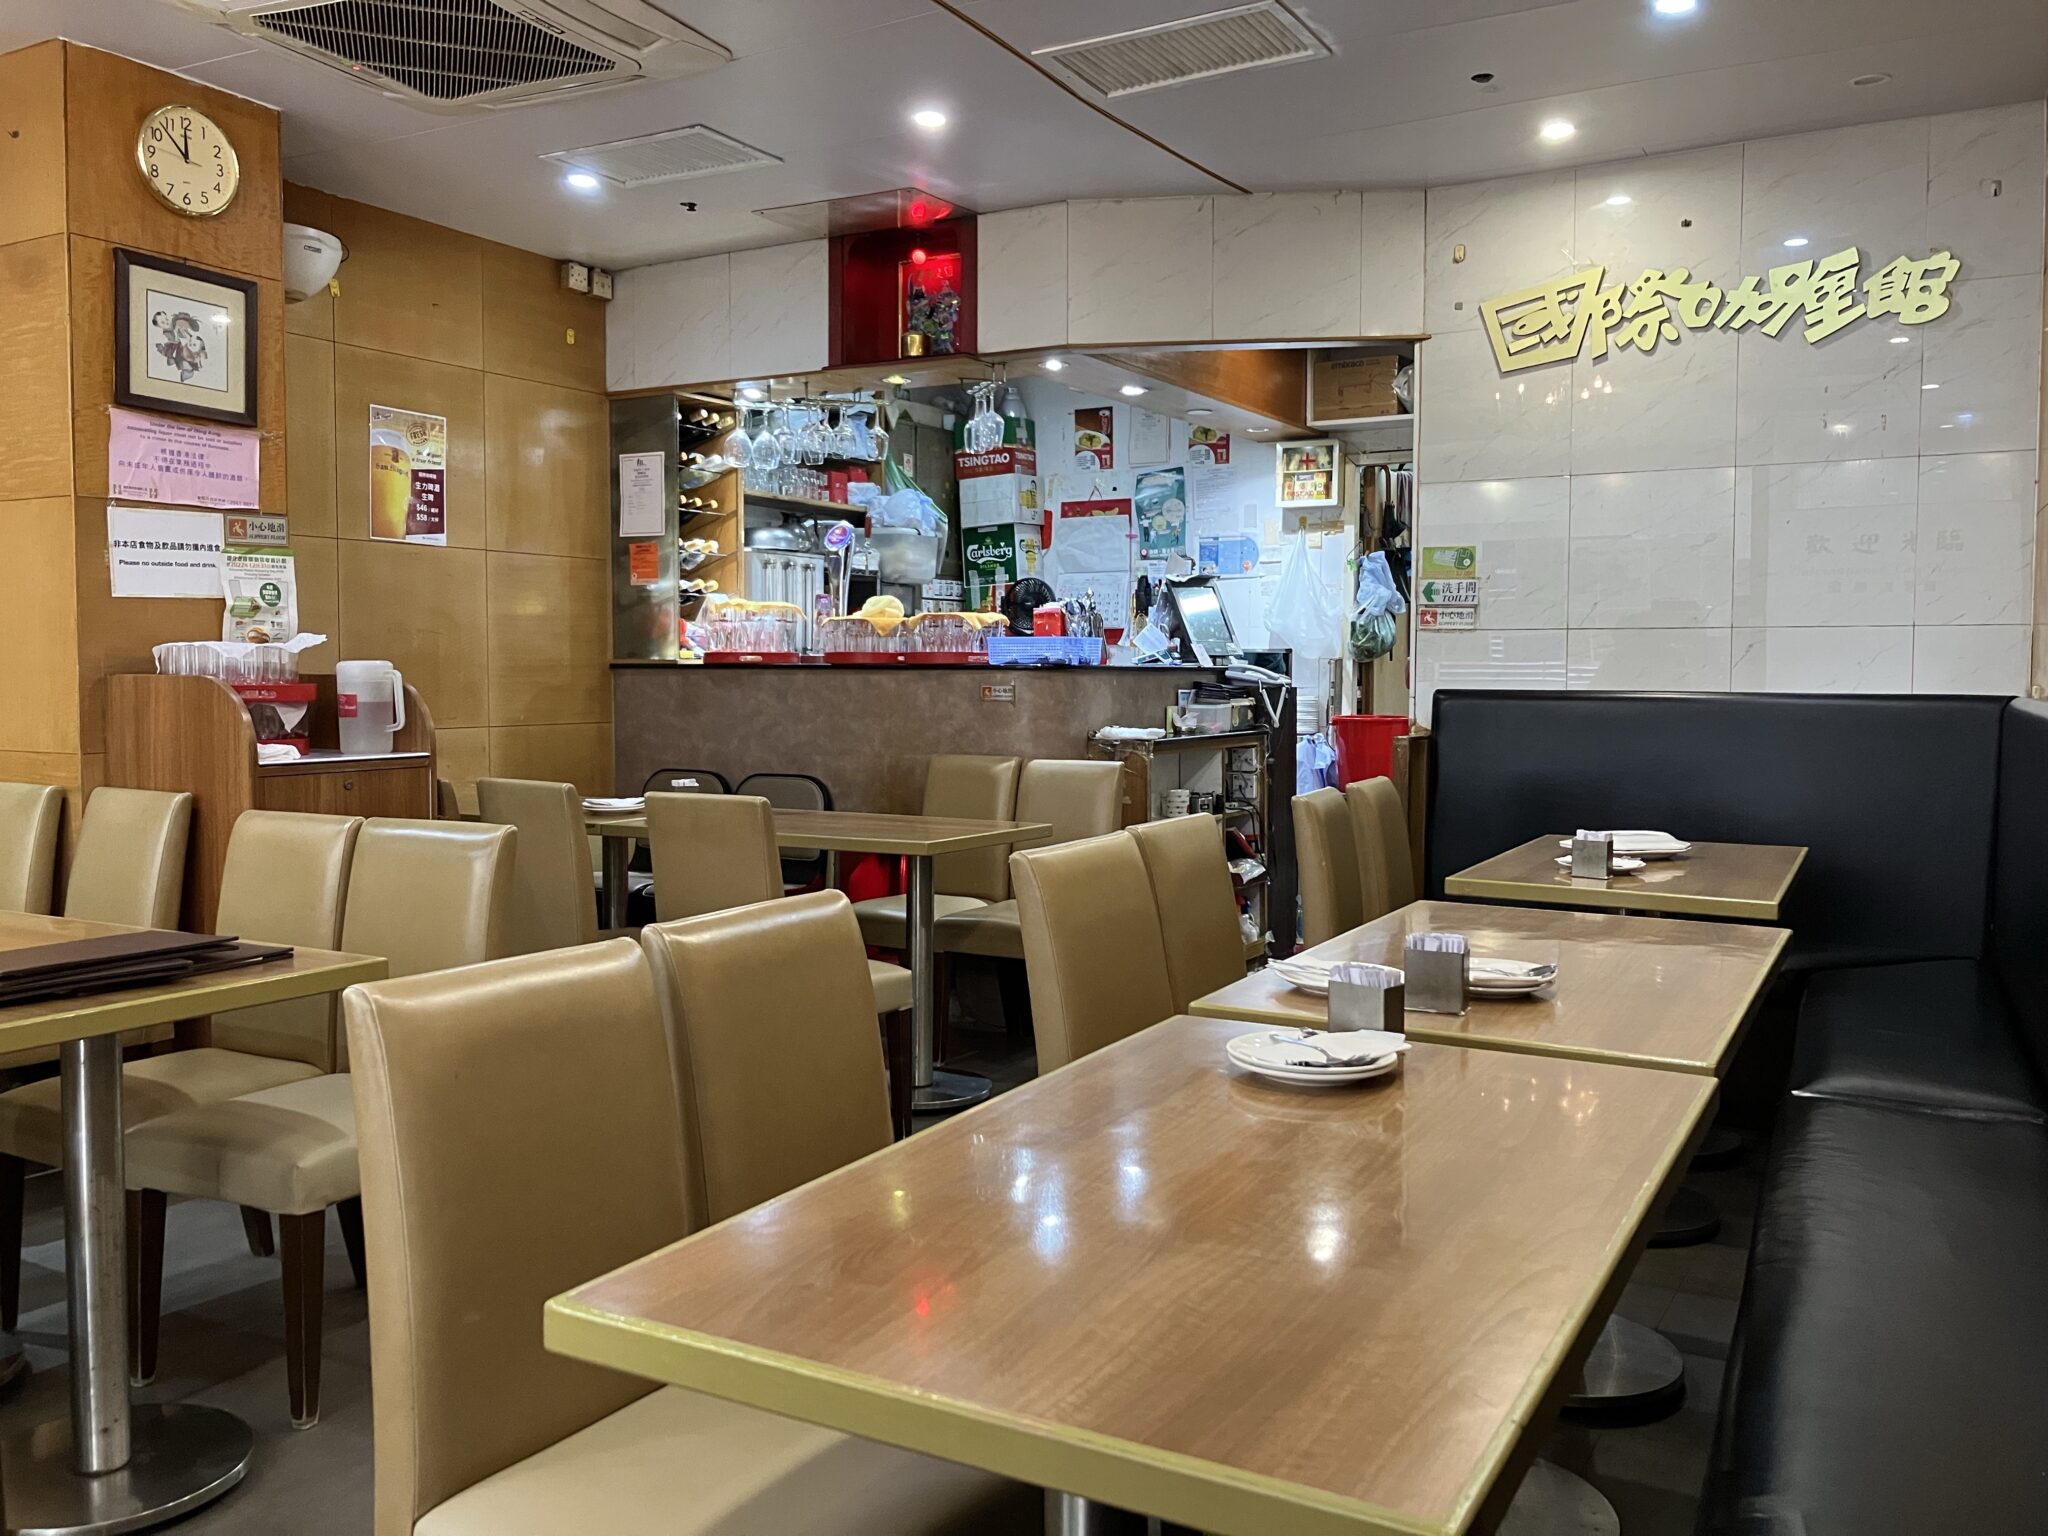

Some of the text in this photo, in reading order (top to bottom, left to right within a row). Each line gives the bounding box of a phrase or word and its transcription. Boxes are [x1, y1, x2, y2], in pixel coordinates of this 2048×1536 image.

[165, 116, 175, 132] 11
[179, 116, 192, 132] 12
[150, 126, 163, 142] 10
[201, 126, 206, 140] 1
[147, 145, 156, 158] 9
[213, 145, 222, 159] 2
[150, 163, 159, 178] 8
[216, 163, 224, 177] 3
[166, 182, 175, 196] 7
[213, 182, 221, 194] 4
[182, 192, 192, 206] 6
[200, 191, 209, 205] 5
[410, 429, 428, 440] FRESH
[957, 453, 1010, 468] TSINGTAO
[415, 481, 440, 493] 生力啤酒
[421, 492, 434, 502] 生啤
[416, 503, 428, 512] $46
[416, 513, 428, 522] $58
[249, 521, 285, 533] 小心地滑
[966, 542, 1013, 562] Carlsberg
[1441, 581, 1477, 594] 洗手間
[1442, 594, 1478, 602] TOILET
[1439, 611, 1474, 620] 小心地滑
